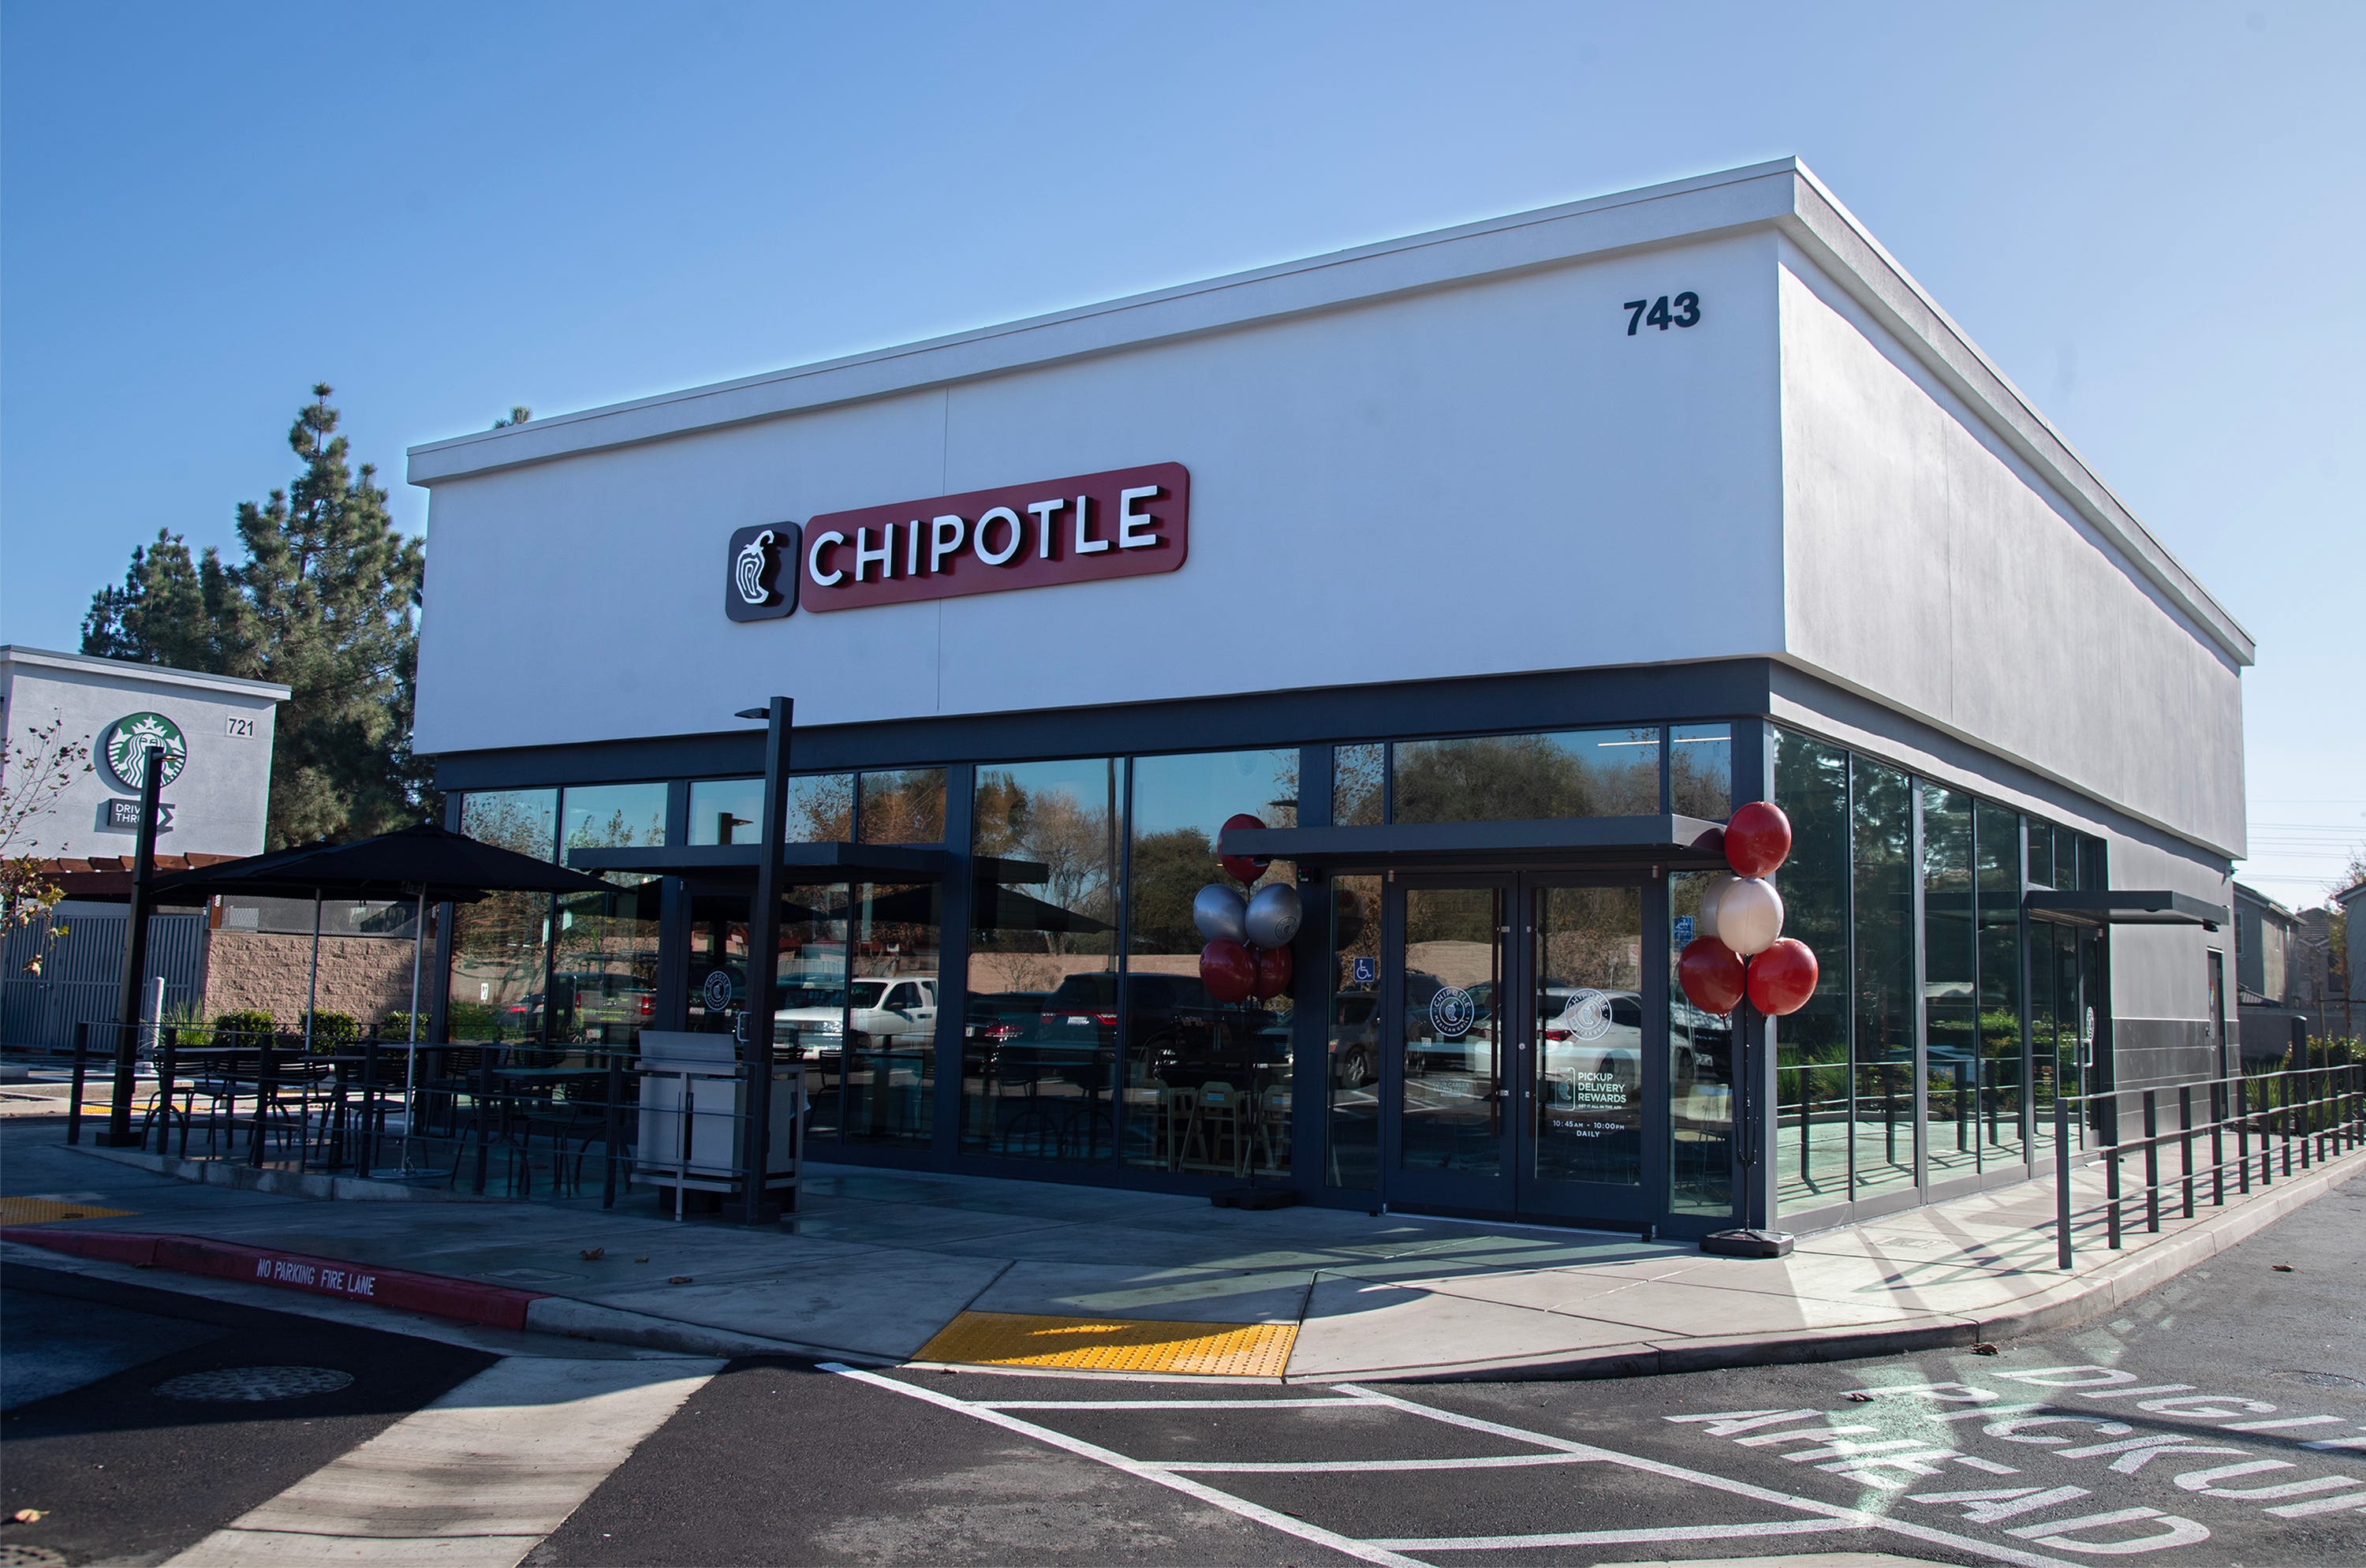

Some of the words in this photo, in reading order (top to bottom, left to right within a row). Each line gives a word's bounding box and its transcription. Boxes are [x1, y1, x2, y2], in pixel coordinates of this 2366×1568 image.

[1623, 291, 1700, 336] 743
[808, 484, 1161, 587] CHIPOTLE
[229, 718, 253, 737] 721
[115, 803, 141, 815] DRIV
[1434, 990, 1471, 1009] CHIPOTLE
[1578, 1072, 1613, 1081] PICKUP
[1578, 1083, 1625, 1092] DELIVERY
[1578, 1093, 1626, 1103] REWARDS
[1593, 1122, 1625, 1130] 10:00PM
[256, 1258, 271, 1278] NO
[274, 1261, 315, 1285] PARKING
[320, 1269, 345, 1290] FIRE
[347, 1273, 376, 1296] LANE
[1660, 1408, 2211, 1555] AHEAD
